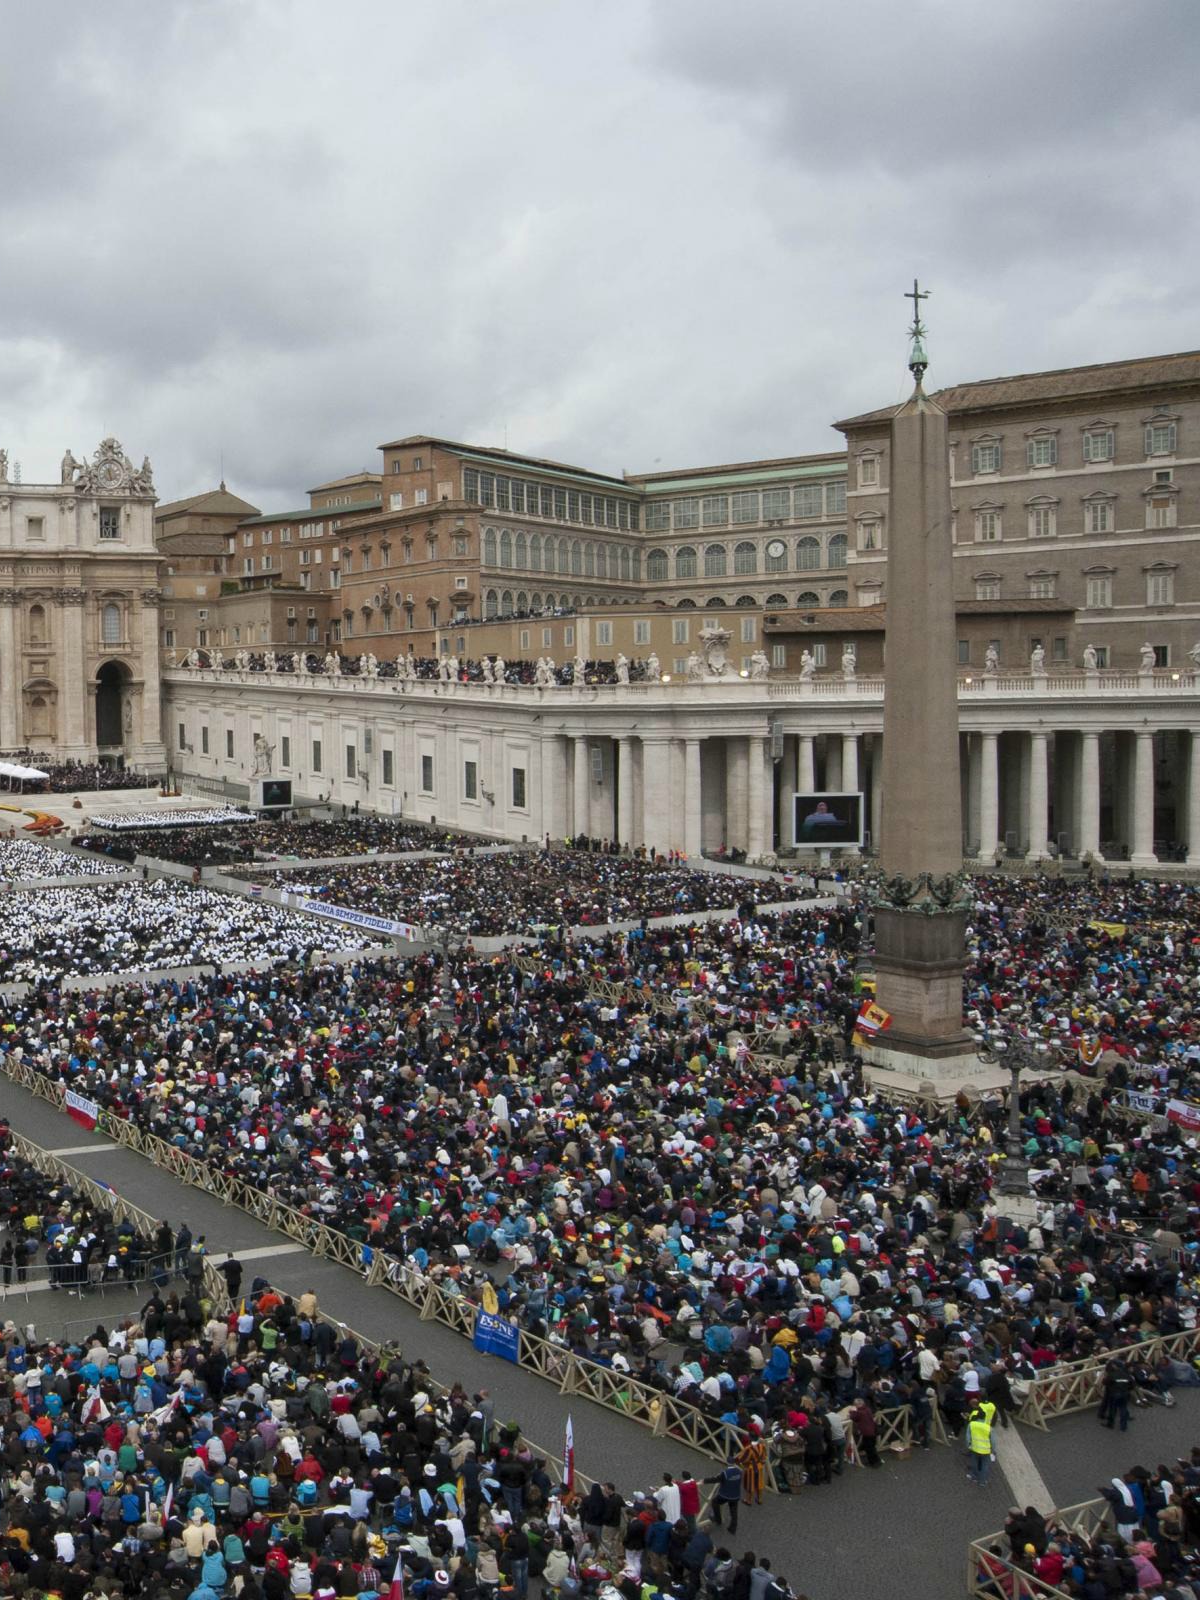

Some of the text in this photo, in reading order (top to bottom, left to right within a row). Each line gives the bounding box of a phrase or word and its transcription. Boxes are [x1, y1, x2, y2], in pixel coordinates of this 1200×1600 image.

[305, 901, 393, 931] POLONIA SEMPER FIDELIS
